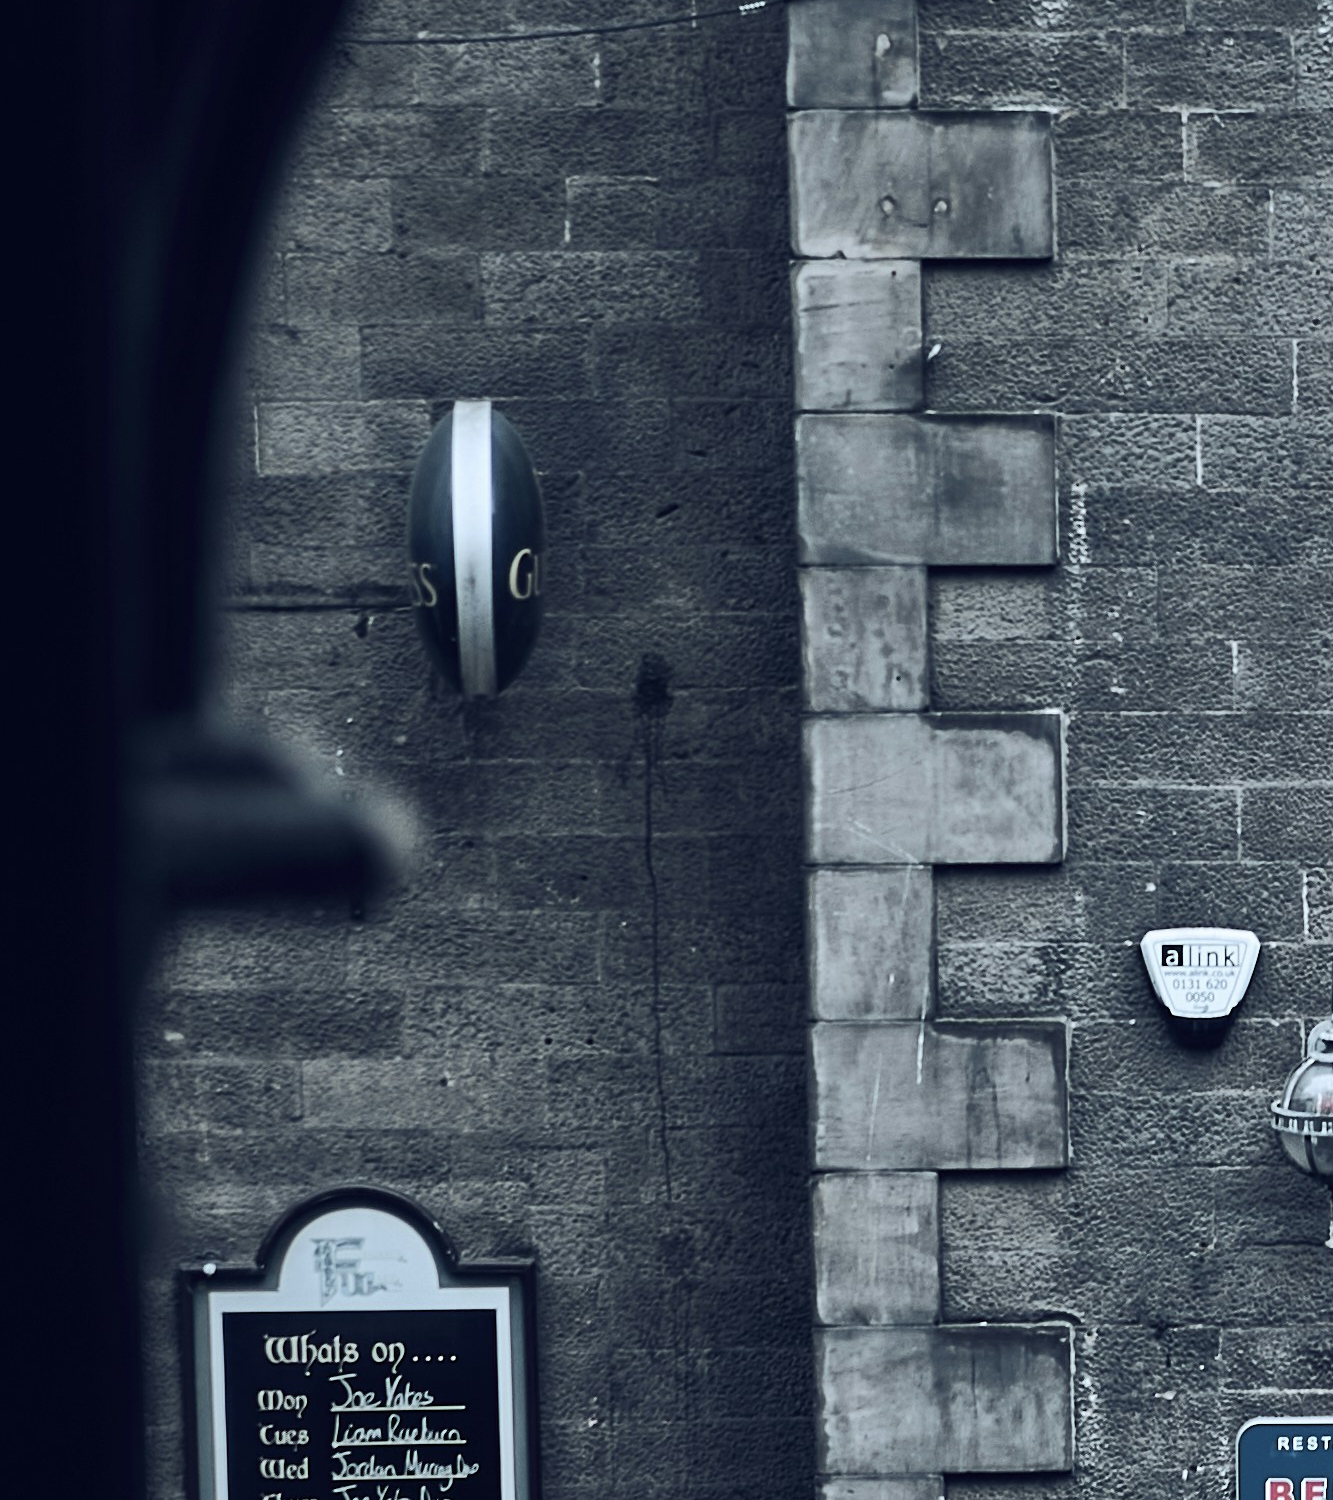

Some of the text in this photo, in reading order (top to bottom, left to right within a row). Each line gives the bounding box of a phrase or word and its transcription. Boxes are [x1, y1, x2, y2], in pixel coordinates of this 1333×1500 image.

[1165, 945, 1236, 967] alink
[1173, 979, 1228, 990] 0131 620
[1186, 991, 1215, 1003] 0050
[329, 1373, 382, 1409] Joe
[257, 1389, 308, 1418] Mon
[331, 1413, 382, 1445] Liam
[259, 1456, 309, 1480] Wed
